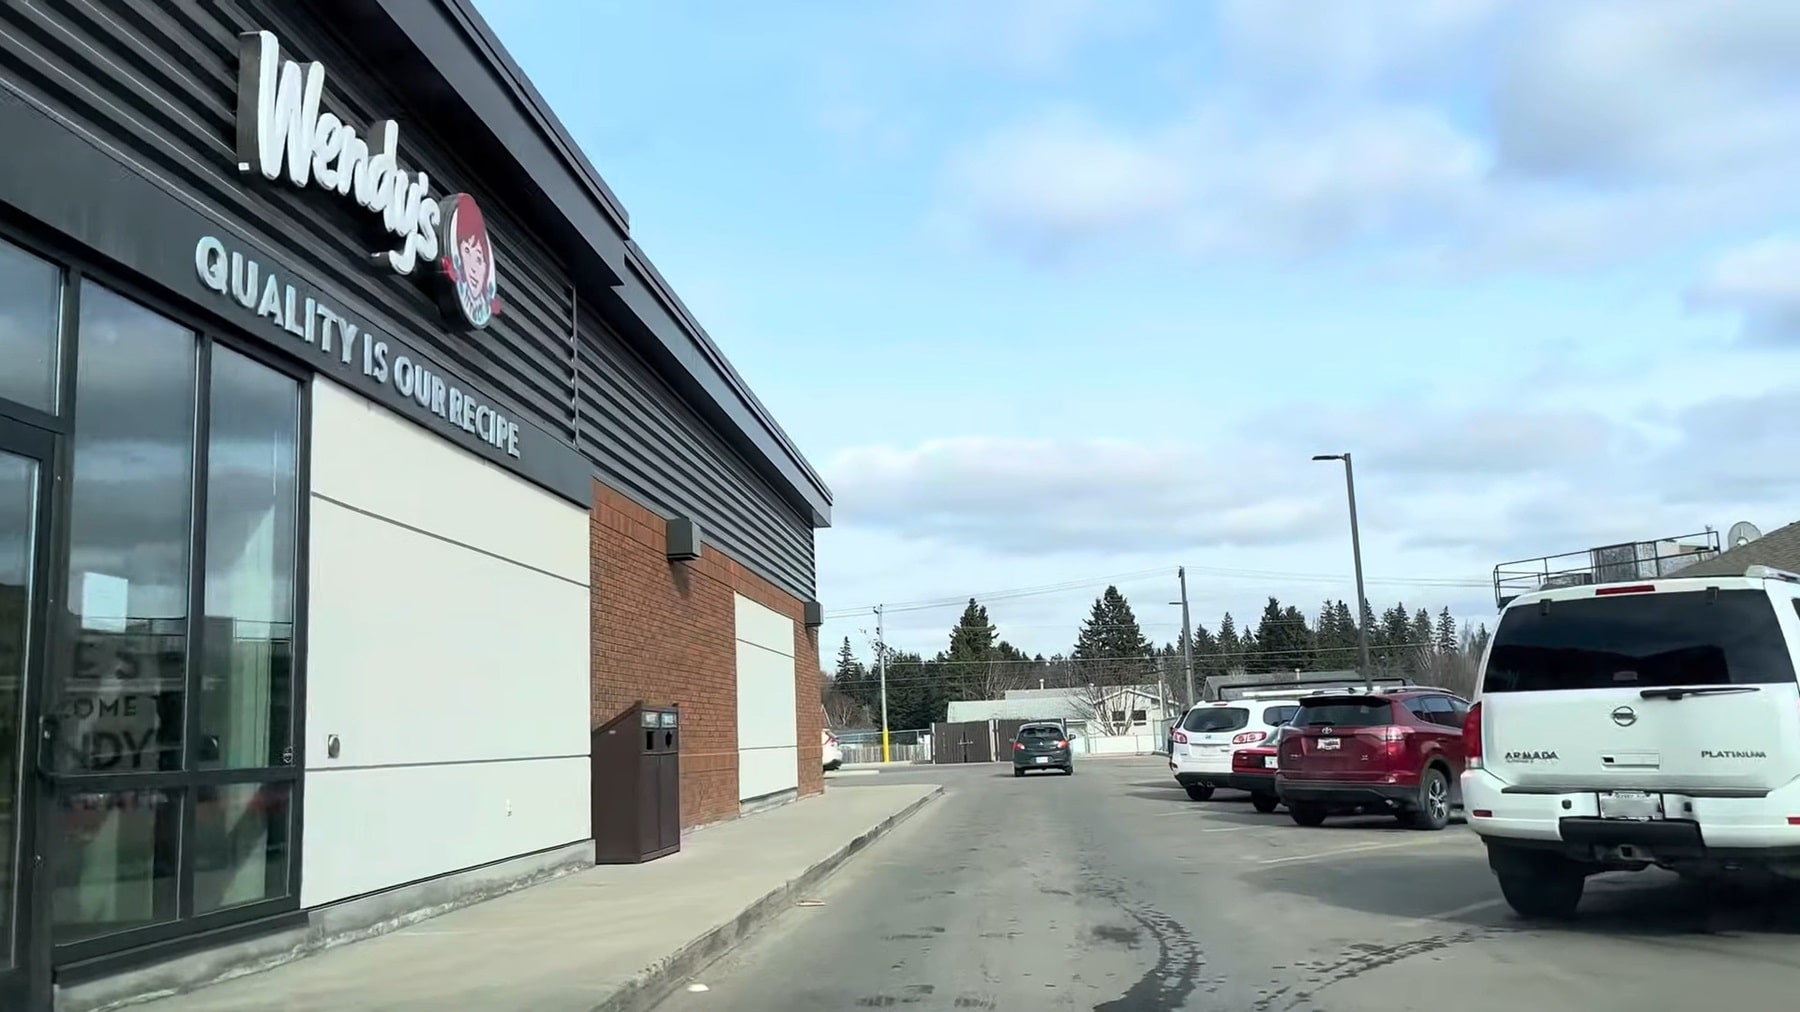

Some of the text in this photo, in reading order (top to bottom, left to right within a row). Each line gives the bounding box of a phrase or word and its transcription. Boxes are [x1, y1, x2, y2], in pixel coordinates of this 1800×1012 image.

[257, 30, 440, 275] Wendy's
[195, 236, 520, 459] QUALITY IS OUR RECIPE
[1504, 751, 1560, 760] ARMADA
[1701, 750, 1767, 759] PLATINUM
